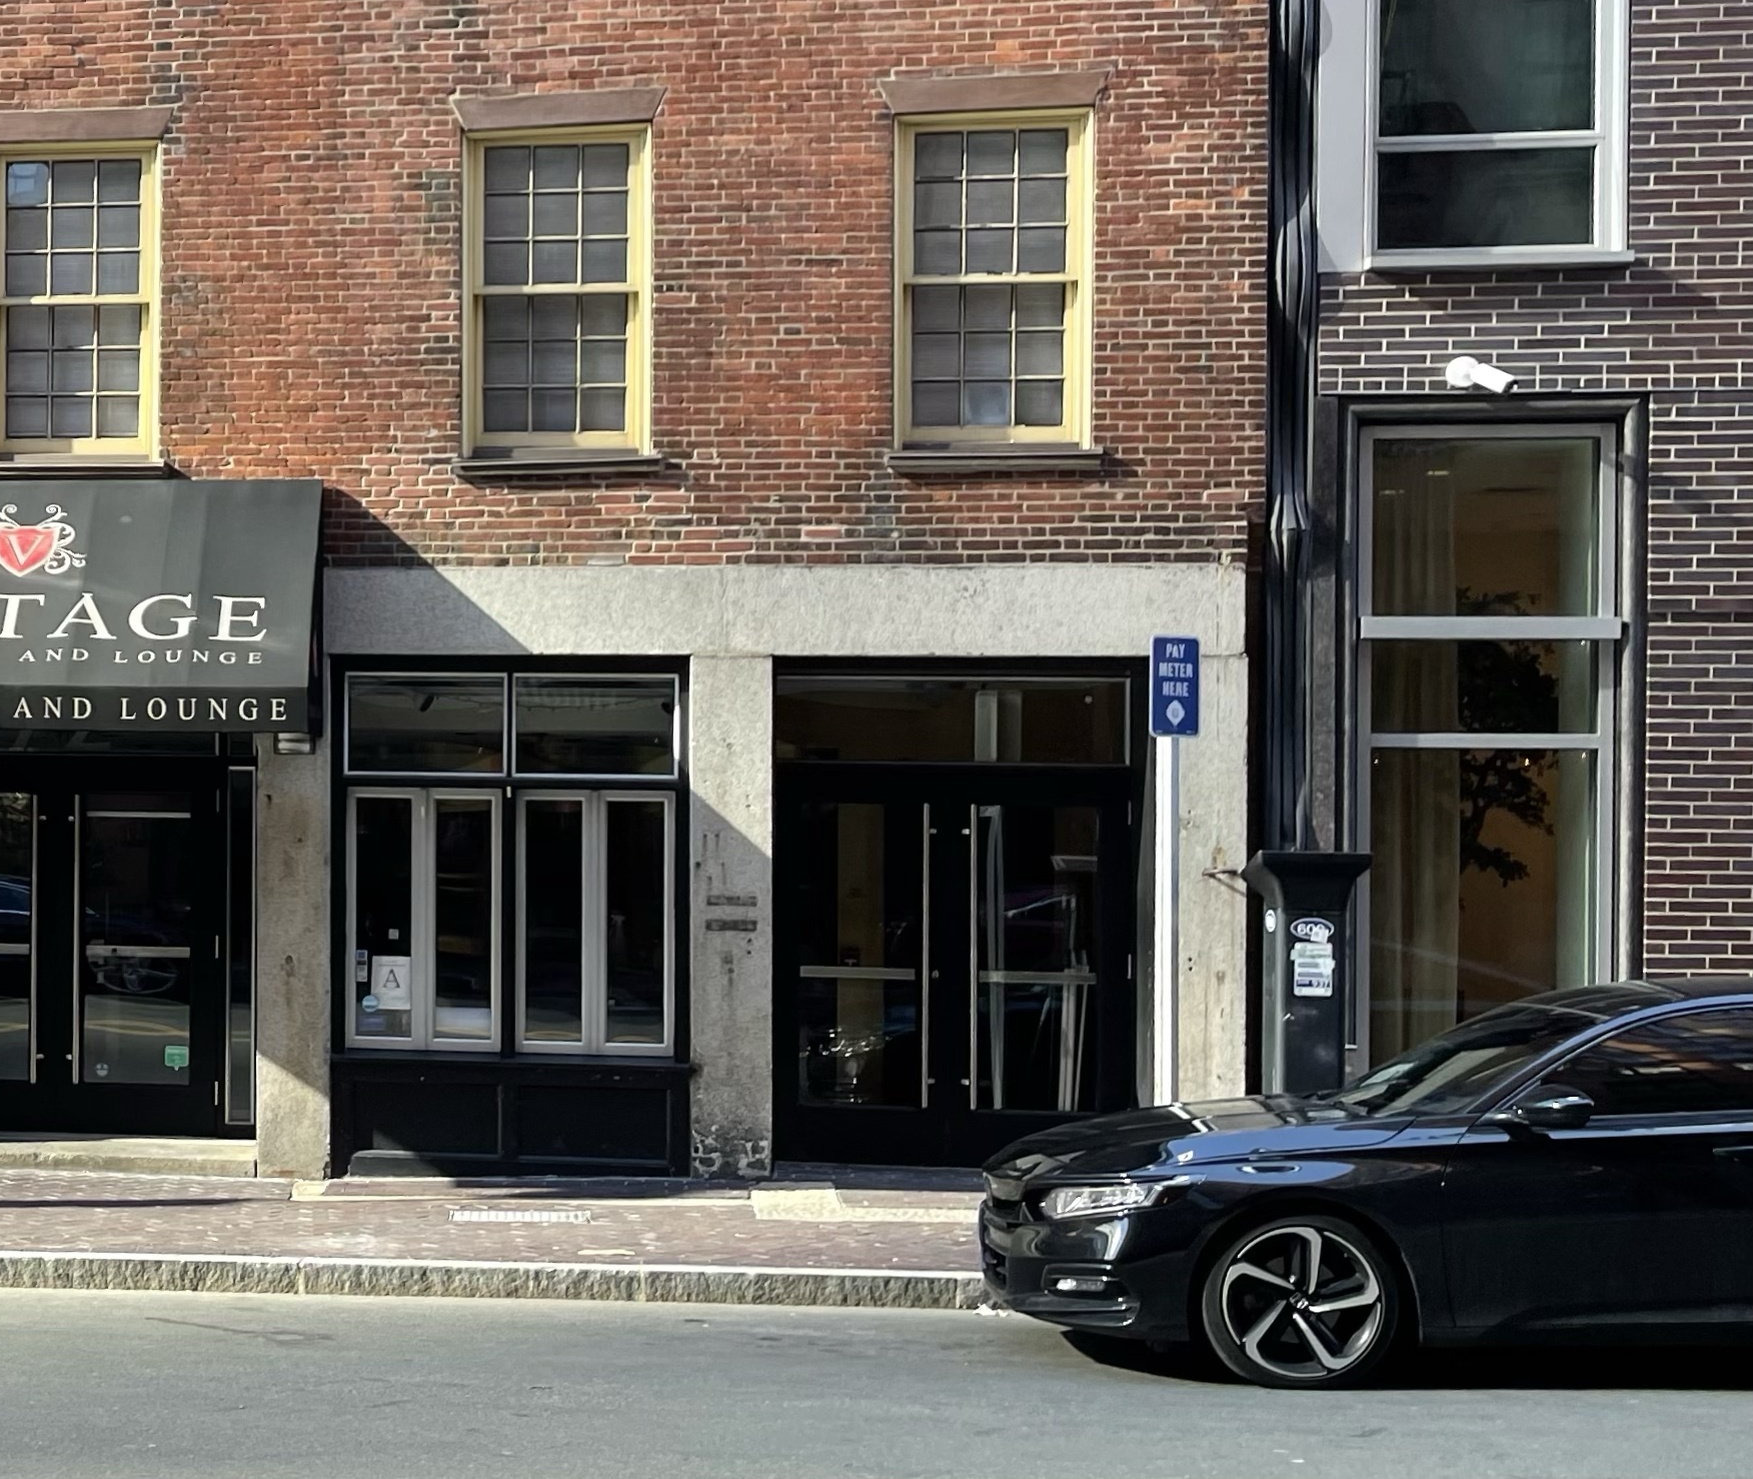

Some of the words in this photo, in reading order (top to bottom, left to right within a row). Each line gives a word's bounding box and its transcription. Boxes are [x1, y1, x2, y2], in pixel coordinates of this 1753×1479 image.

[18, 647, 90, 663] AND
[113, 648, 264, 665] LOUNGE
[1166, 643, 1186, 658] PAY
[1158, 662, 1193, 678] METER
[1162, 681, 1189, 697] HERE
[13, 696, 93, 720] AND
[120, 697, 289, 722] LOUNGE
[382, 968, 400, 988] A
